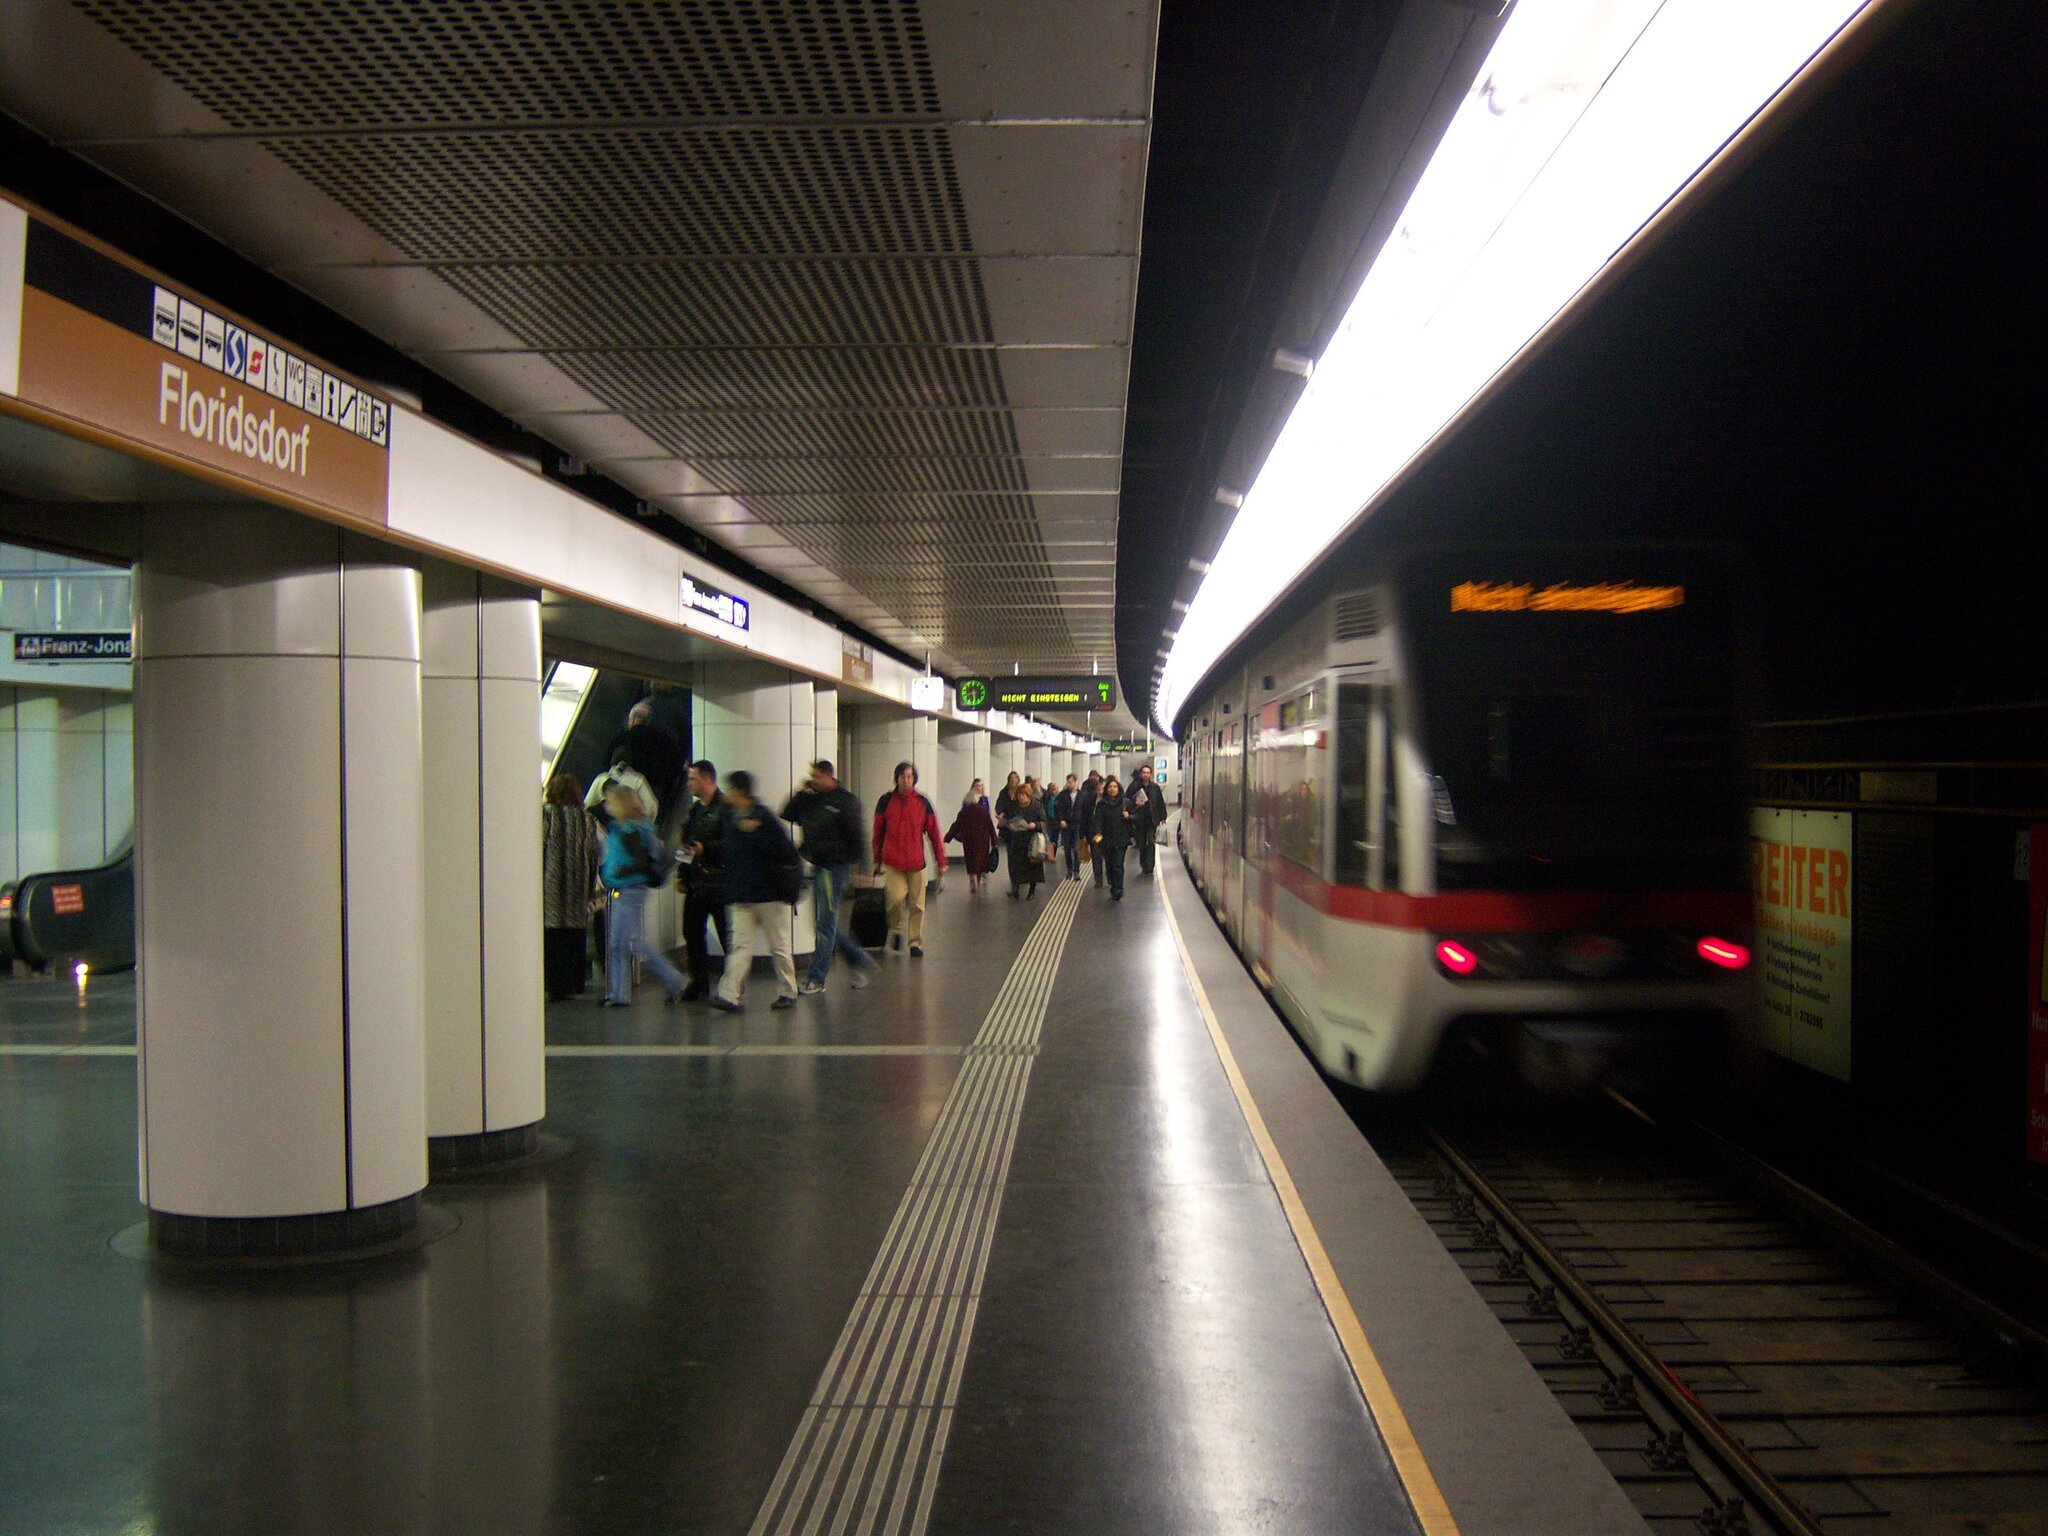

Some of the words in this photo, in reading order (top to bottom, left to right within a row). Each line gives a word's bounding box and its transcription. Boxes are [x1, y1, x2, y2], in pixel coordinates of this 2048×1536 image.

[288, 359, 304, 384] WC
[159, 361, 310, 477] Floridsdorf
[1001, 694, 1027, 703] NICHT
[1030, 694, 1080, 703] EINSTEIGEN
[1100, 691, 1107, 702] 1
